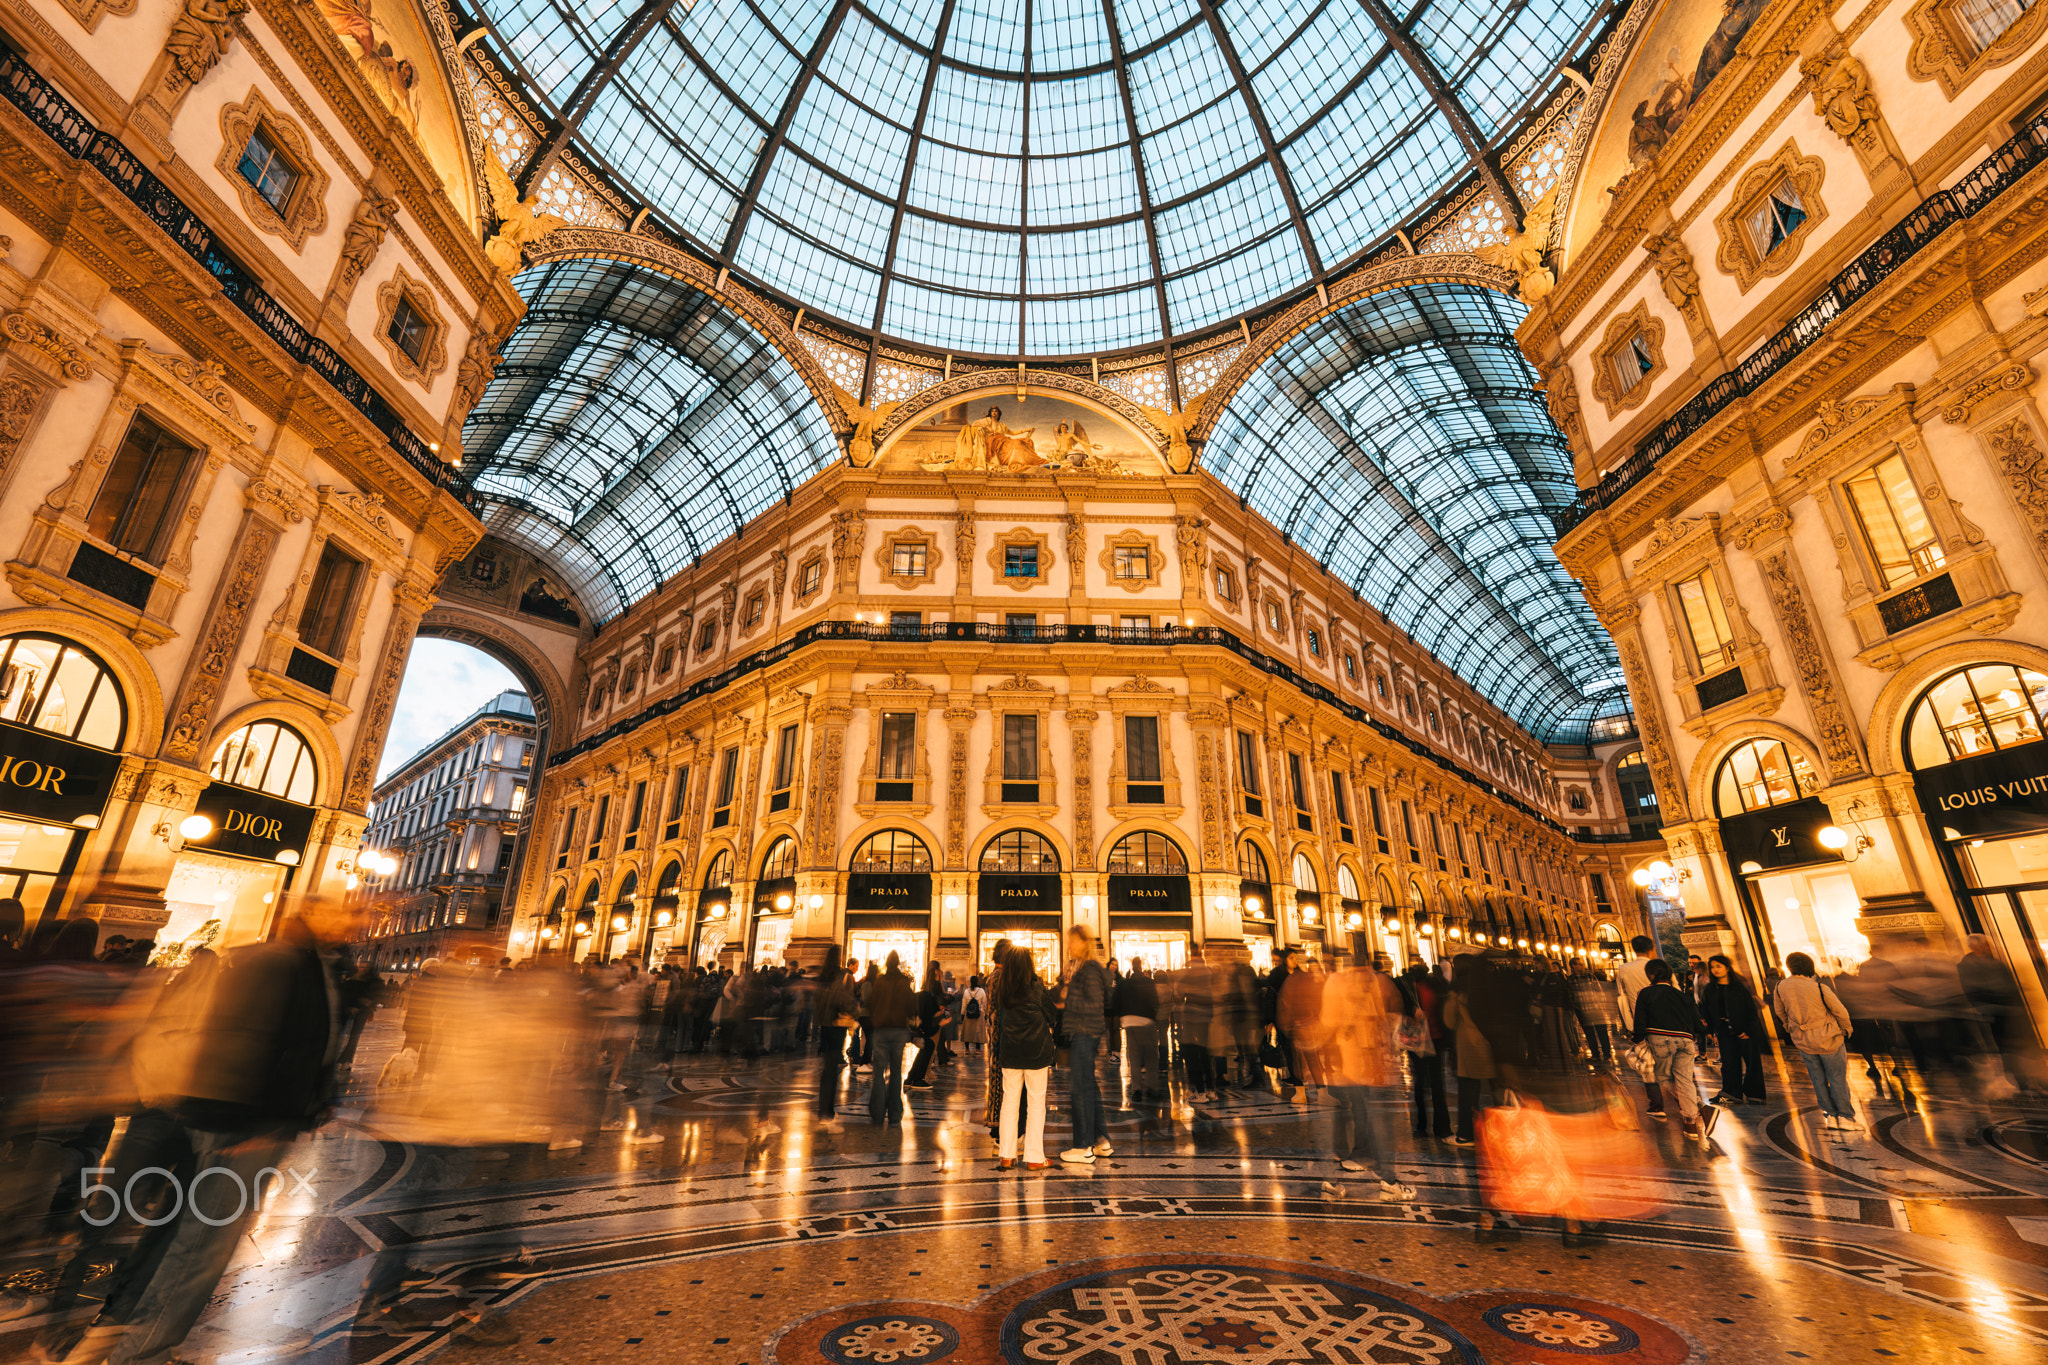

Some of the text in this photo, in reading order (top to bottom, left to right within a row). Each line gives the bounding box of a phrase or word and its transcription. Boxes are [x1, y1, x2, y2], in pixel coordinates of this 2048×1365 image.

[1939, 774, 2048, 812] LOUIS VUIT
[224, 808, 283, 842] DIOR
[870, 887, 909, 896] PRADA
[1000, 889, 1039, 897] PRADA
[1130, 889, 1168, 897] PRADA
